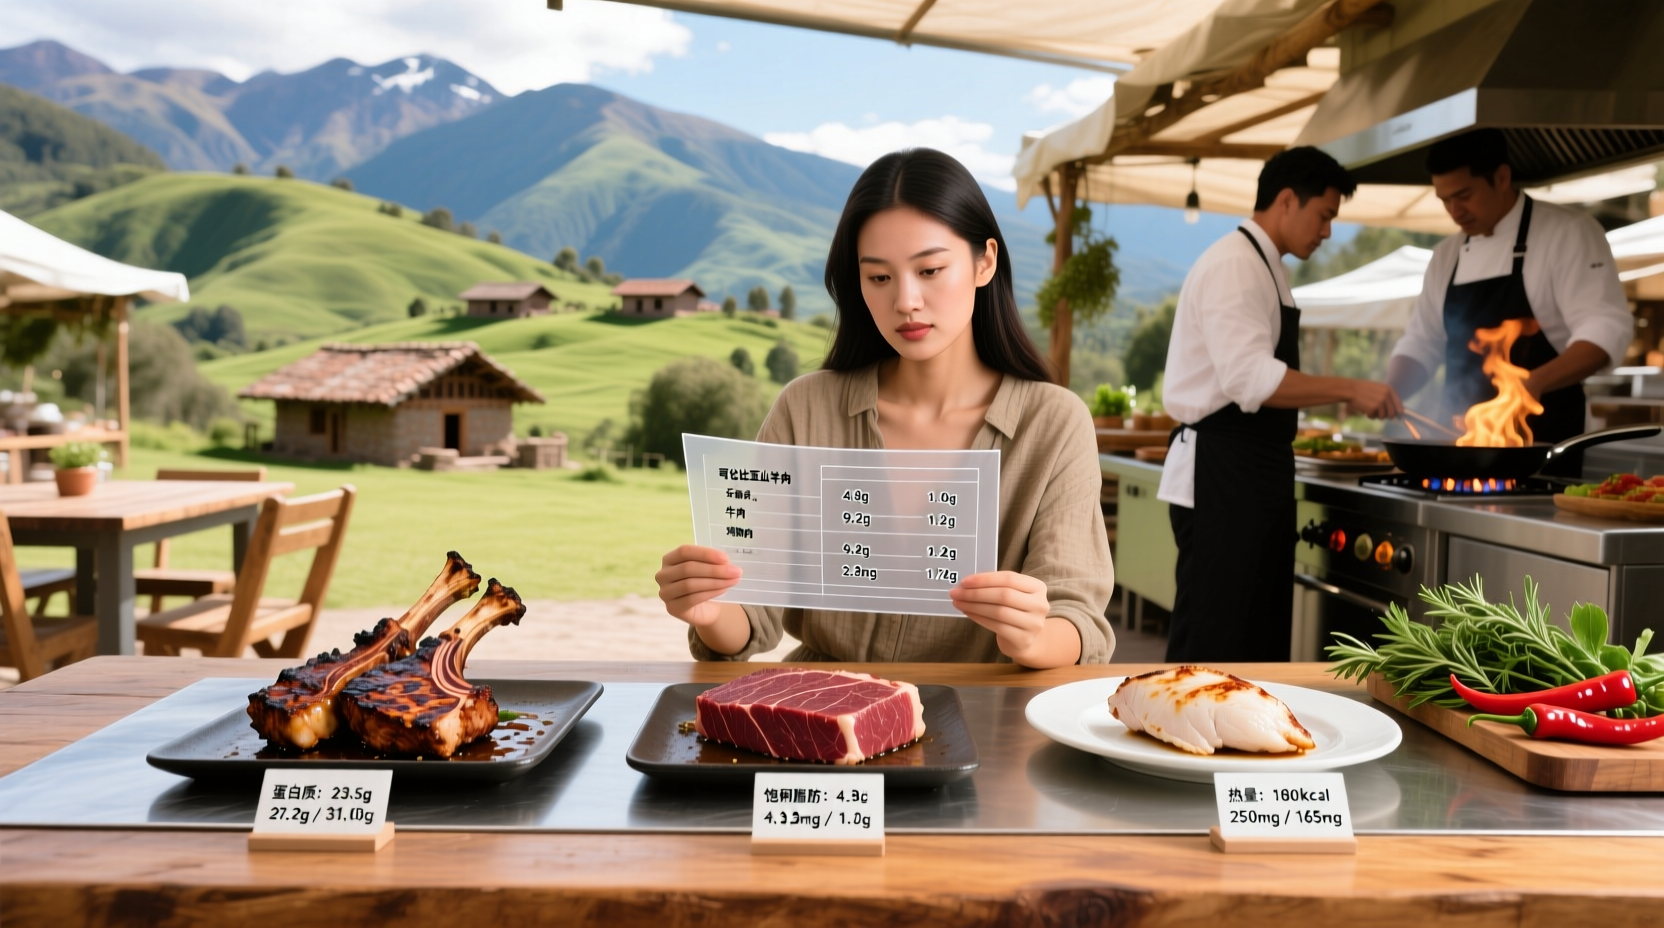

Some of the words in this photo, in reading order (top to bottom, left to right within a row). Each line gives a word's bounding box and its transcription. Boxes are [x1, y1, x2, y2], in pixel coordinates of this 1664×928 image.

[725, 505, 746, 519] 牛肉
[843, 512, 871, 527] 9.2g
[929, 514, 955, 529] 1.2g
[843, 543, 870, 559] 9.2g
[268, 806, 310, 825] 27.2g
[839, 812, 871, 829] 1.0g
[1230, 810, 1280, 828] 250mg
